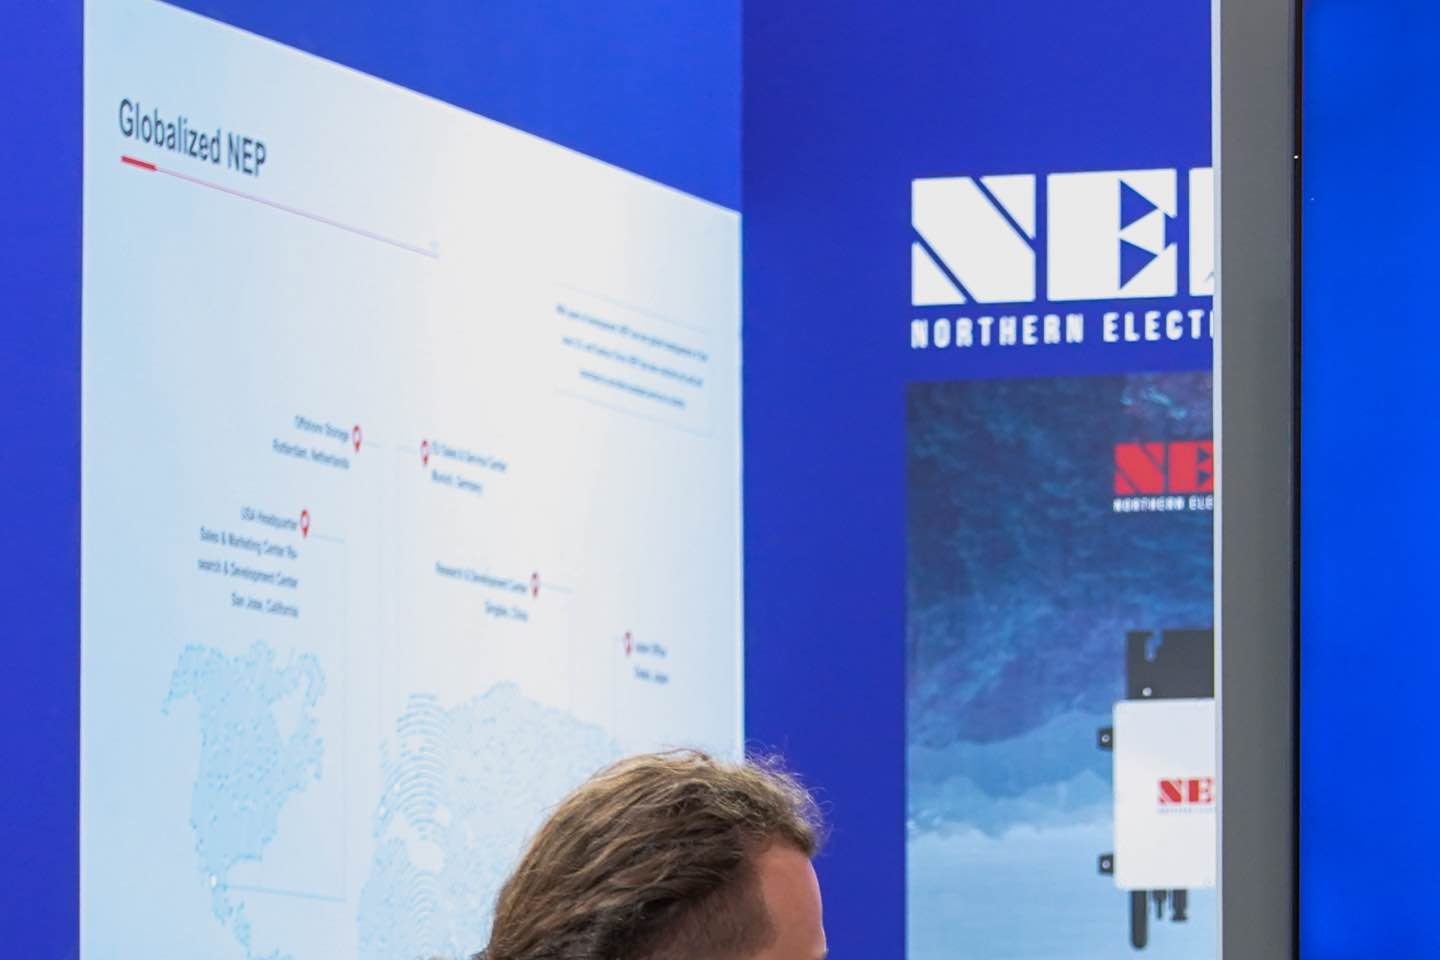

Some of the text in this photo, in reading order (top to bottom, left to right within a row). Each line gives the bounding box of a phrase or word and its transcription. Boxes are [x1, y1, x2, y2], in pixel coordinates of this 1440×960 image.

[119, 98, 266, 176] Globalized NEP
[911, 167, 1214, 306] NE
[911, 308, 1214, 349] NORTHERN ELECT
